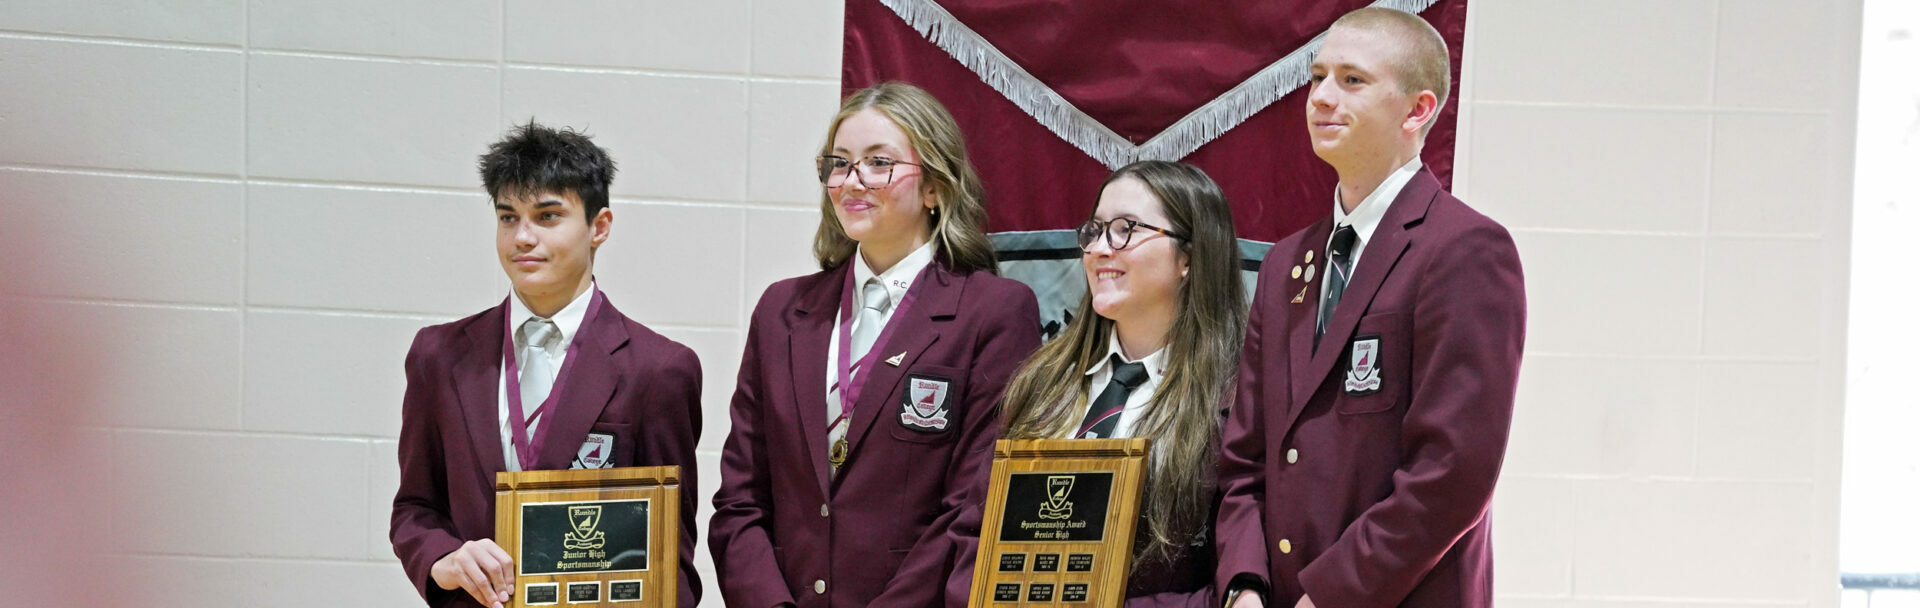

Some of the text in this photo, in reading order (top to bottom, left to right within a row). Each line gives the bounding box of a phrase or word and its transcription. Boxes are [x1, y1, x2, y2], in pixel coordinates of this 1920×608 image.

[1021, 520, 1086, 530] Sportsmanship Award
[1034, 530, 1069, 540] Senior High
[563, 550, 606, 559] Junior High
[557, 560, 611, 570] Sportsmanship
